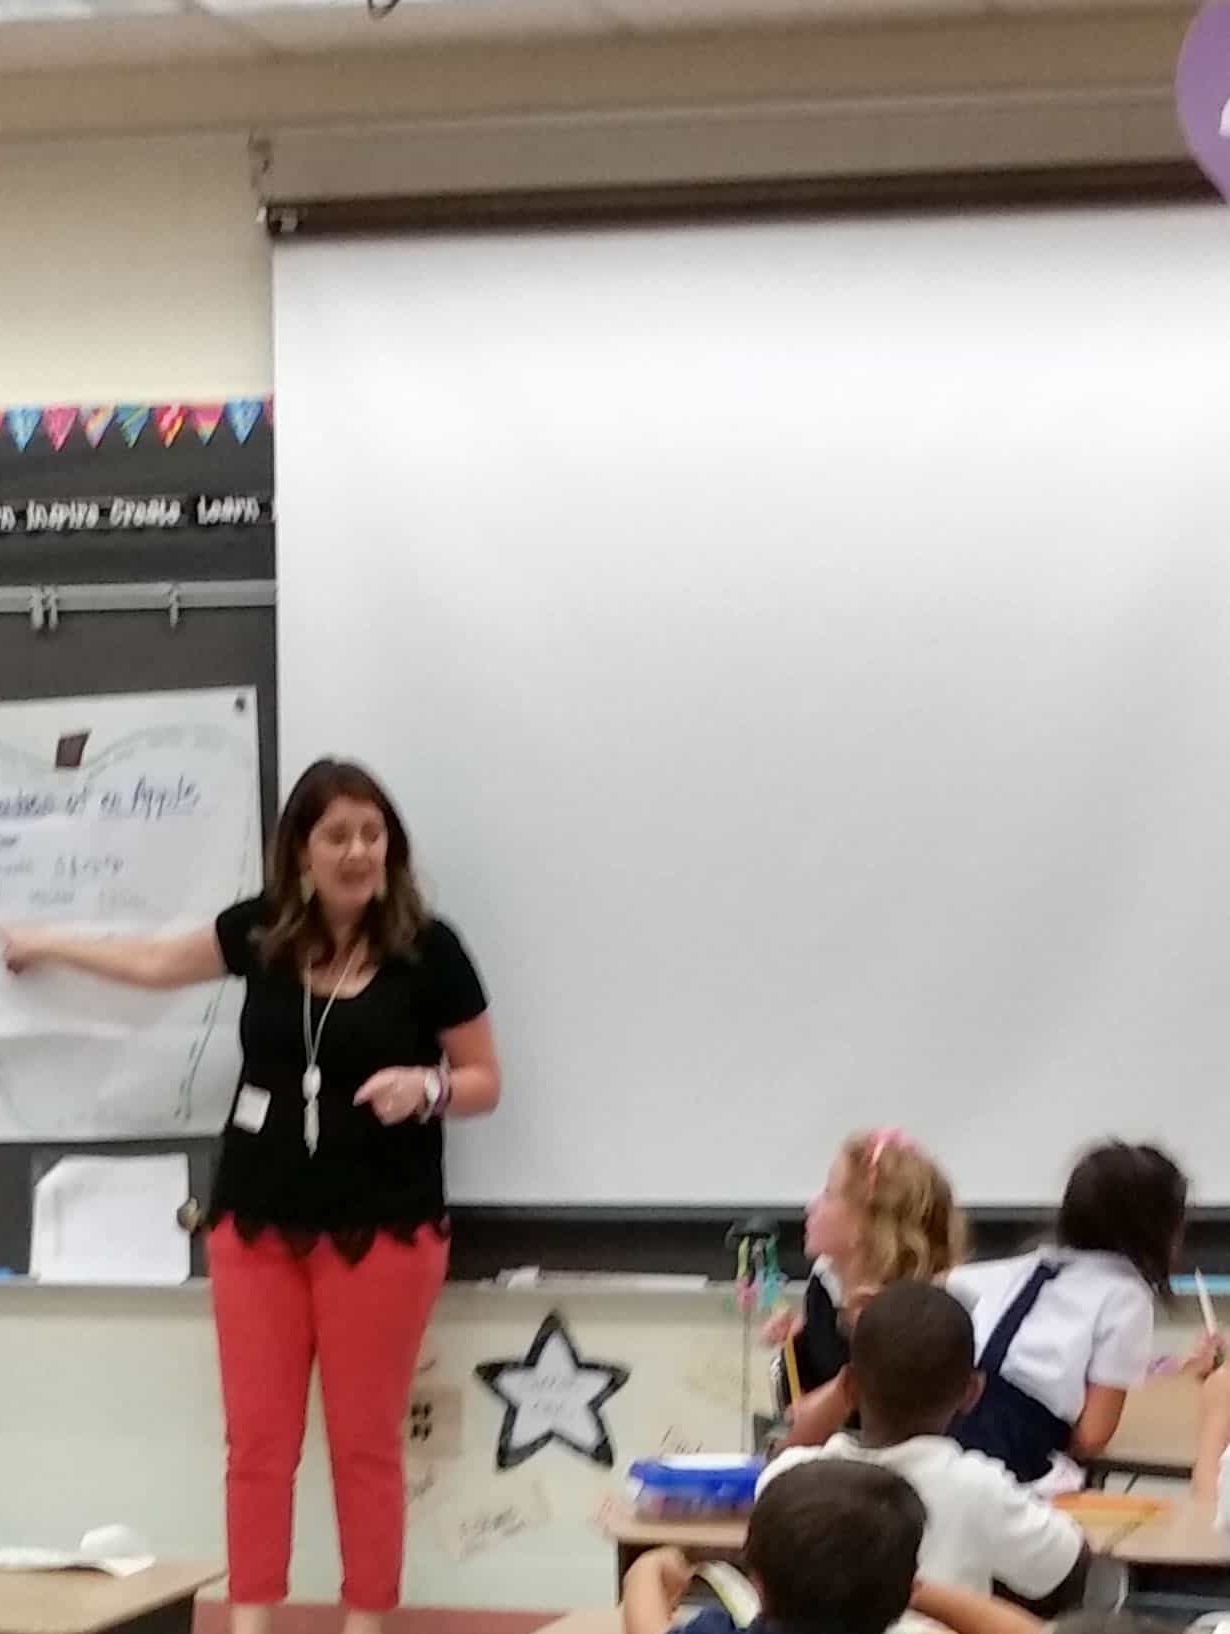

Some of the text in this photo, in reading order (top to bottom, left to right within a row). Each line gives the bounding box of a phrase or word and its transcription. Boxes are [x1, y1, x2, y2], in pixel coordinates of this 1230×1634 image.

[26, 498, 99, 531] Inspire
[110, 497, 181, 527] Create
[197, 494, 260, 526] Learn
